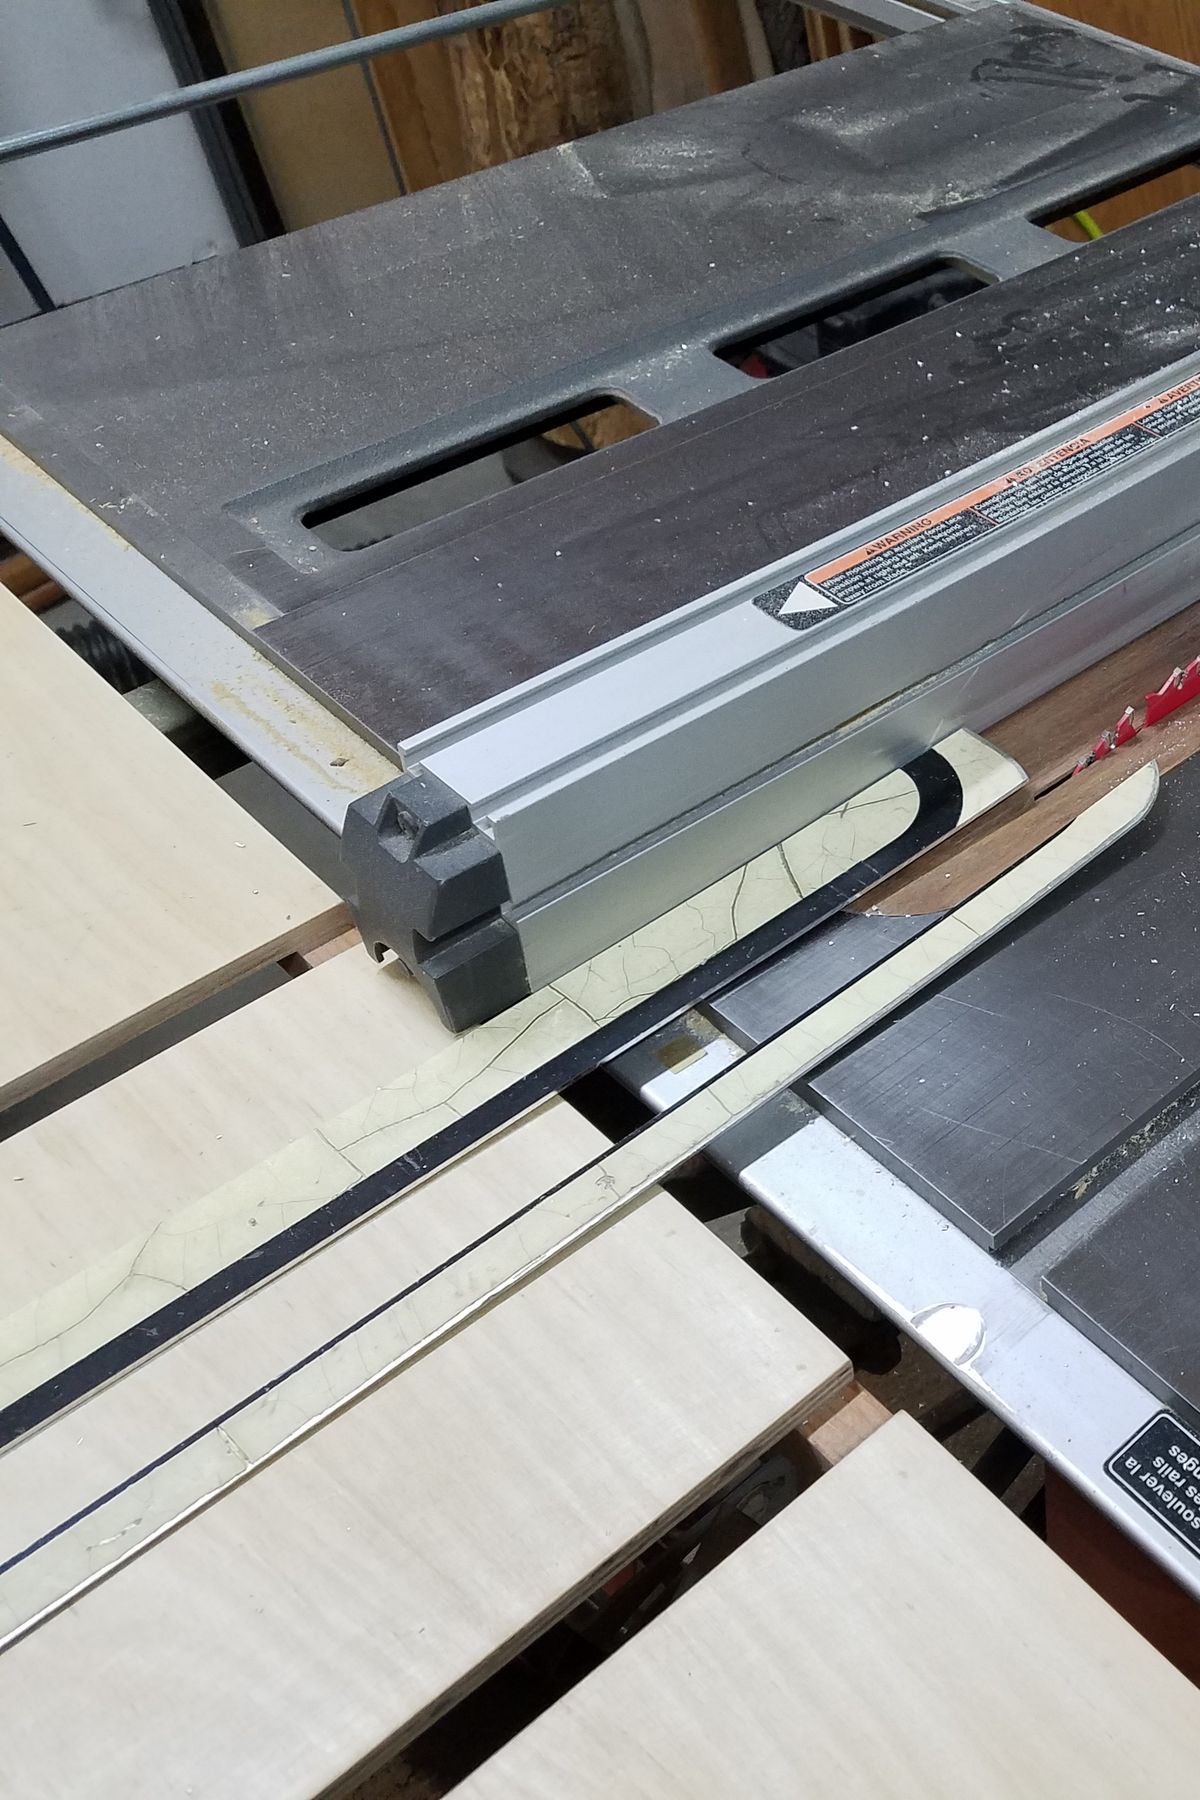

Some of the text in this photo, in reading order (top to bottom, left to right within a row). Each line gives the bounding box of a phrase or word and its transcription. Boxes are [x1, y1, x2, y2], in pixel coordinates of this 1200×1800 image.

[1015, 437, 1091, 476] ADERTENCIA
[871, 517, 932, 550] WARNING
[1125, 1457, 1141, 1475] la
[1153, 1457, 1186, 1487] rails
